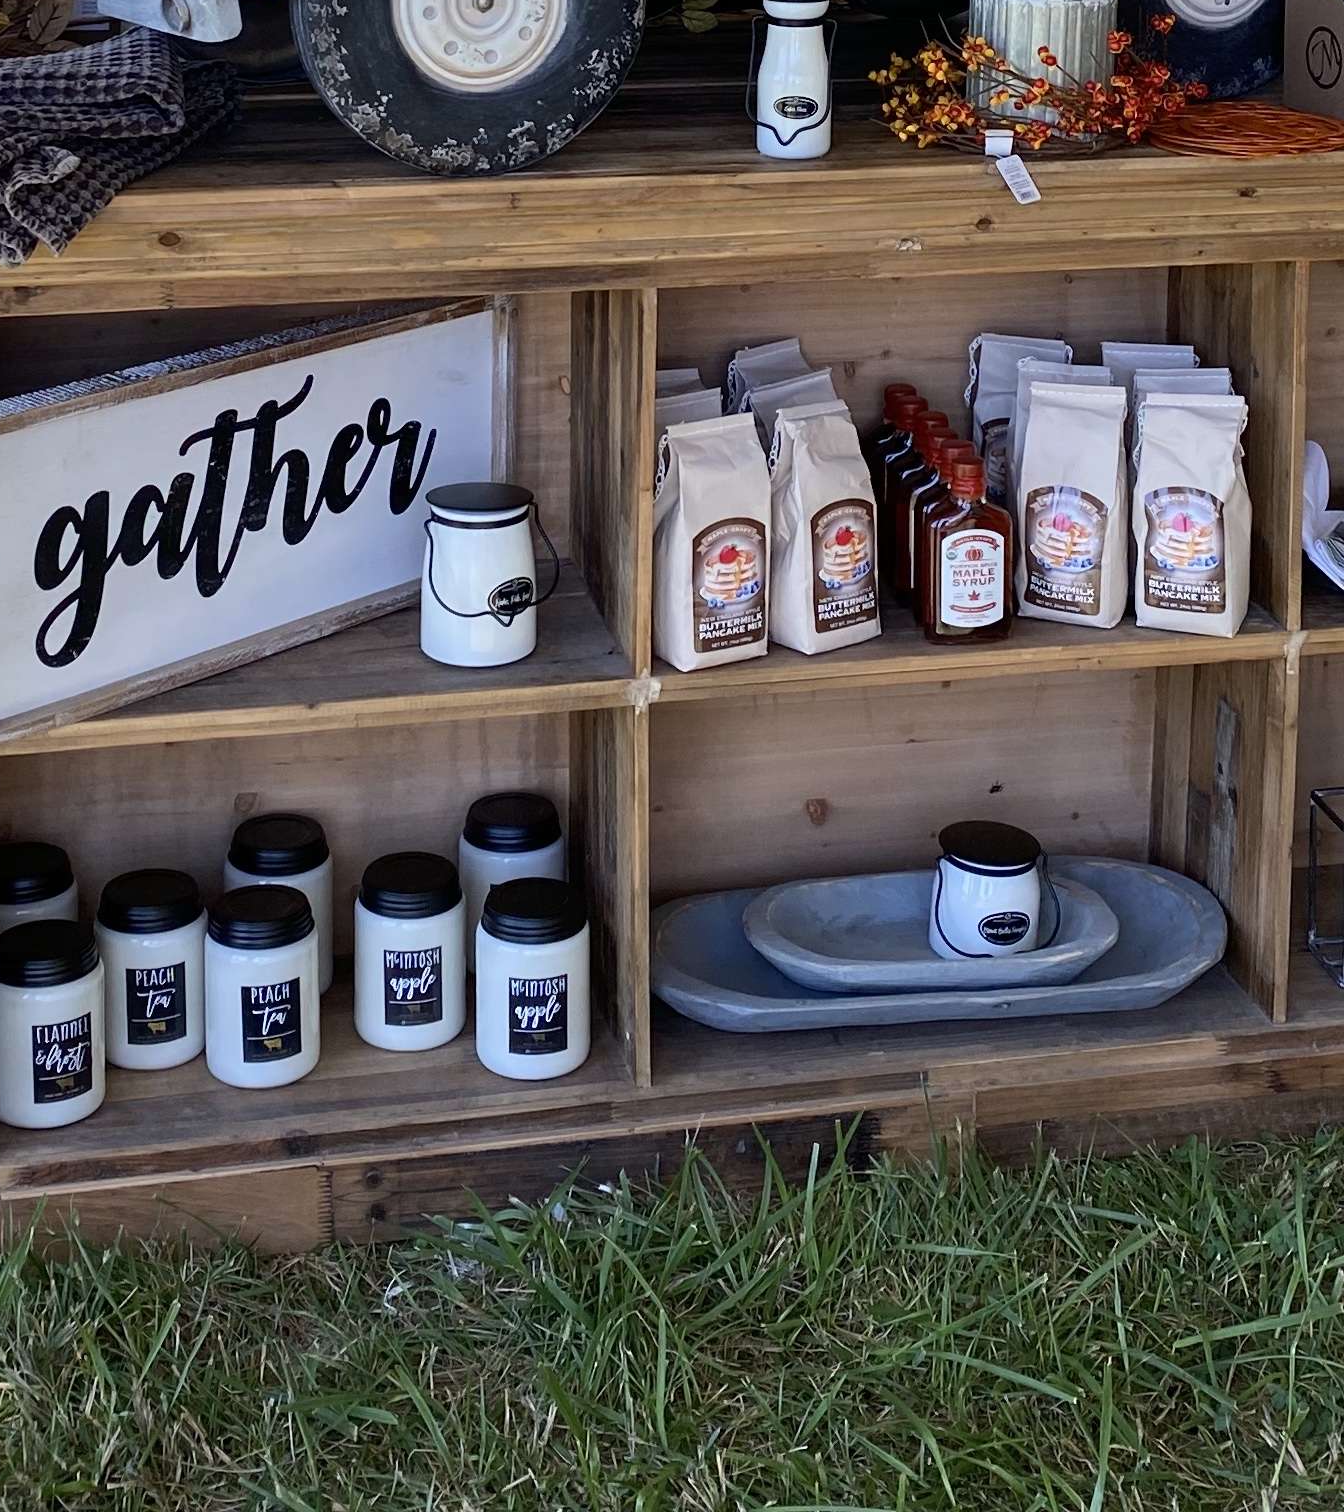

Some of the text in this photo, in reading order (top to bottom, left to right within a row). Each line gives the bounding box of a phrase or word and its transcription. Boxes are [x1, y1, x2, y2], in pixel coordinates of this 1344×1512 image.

[34, 374, 438, 669] gather
[952, 568, 996, 578] MAPLE
[952, 577, 996, 587] SYRUP
[1030, 584, 1094, 604] PANCAKE MIX
[1031, 575, 1095, 596] BUTTERMILK
[1148, 578, 1220, 594] BUTTERMILK
[1149, 588, 1220, 602] PANCAKE MIX
[817, 591, 875, 613] BUTTERMILK
[818, 604, 861, 621] PANCAKE
[861, 599, 876, 610] MIX
[699, 612, 763, 632] BUTTERMILK
[699, 620, 763, 640] PANCAKE MIX
[135, 967, 175, 987] PEACH
[389, 966, 437, 1001] apple
[136, 988, 176, 1017] tea
[250, 983, 290, 1005] PEACH
[251, 1004, 292, 1036] tea
[514, 994, 562, 1029] apple
[35, 1041, 91, 1074] & frost
